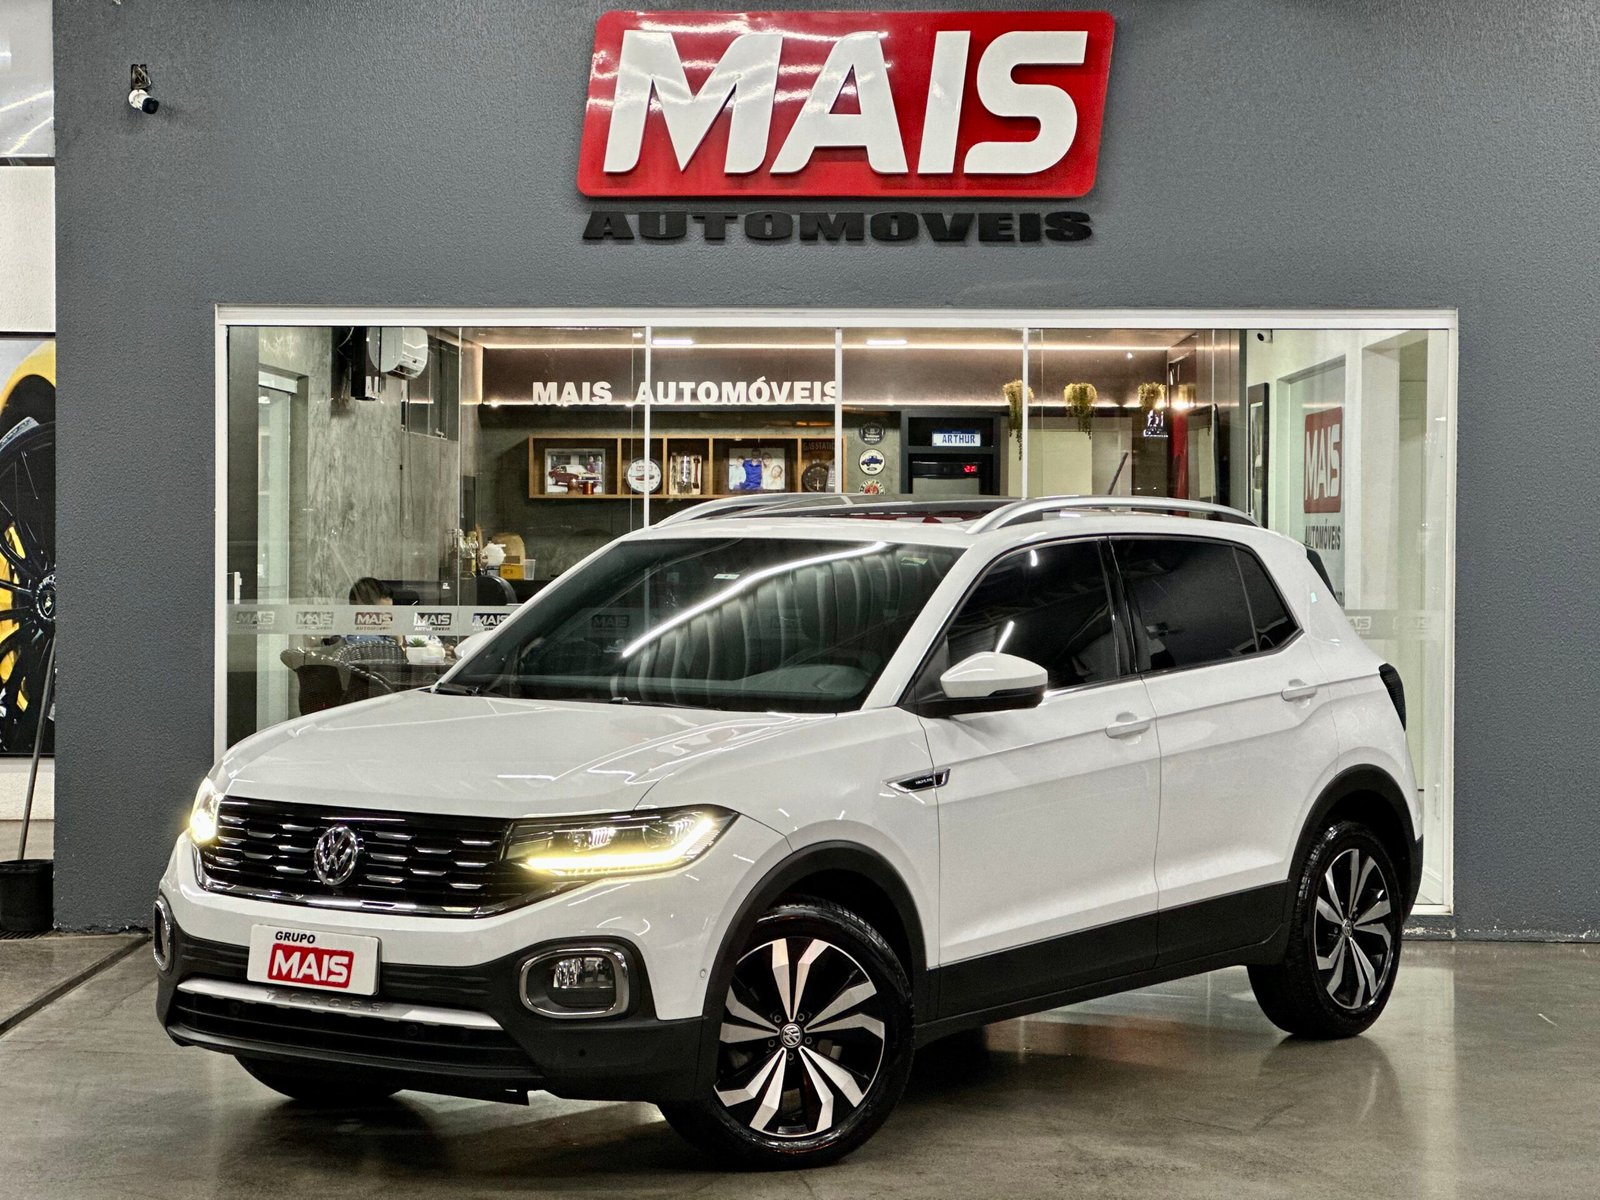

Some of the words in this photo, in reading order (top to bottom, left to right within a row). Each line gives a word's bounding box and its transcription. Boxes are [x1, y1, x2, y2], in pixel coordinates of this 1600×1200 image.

[603, 29, 1089, 175] MAIS
[582, 210, 1093, 242] AUTOMOVEIS
[532, 381, 613, 404] MAIS
[634, 376, 836, 404] AUTOMÓVEIS
[942, 434, 976, 444] ARTHUR
[1306, 423, 1341, 501] MAIS
[1305, 518, 1341, 550] AUTOMÓVEIS
[357, 614, 391, 625] MAIS
[415, 614, 450, 625] MAIS
[275, 931, 316, 944] GRUPO
[272, 949, 350, 984] MAIS
